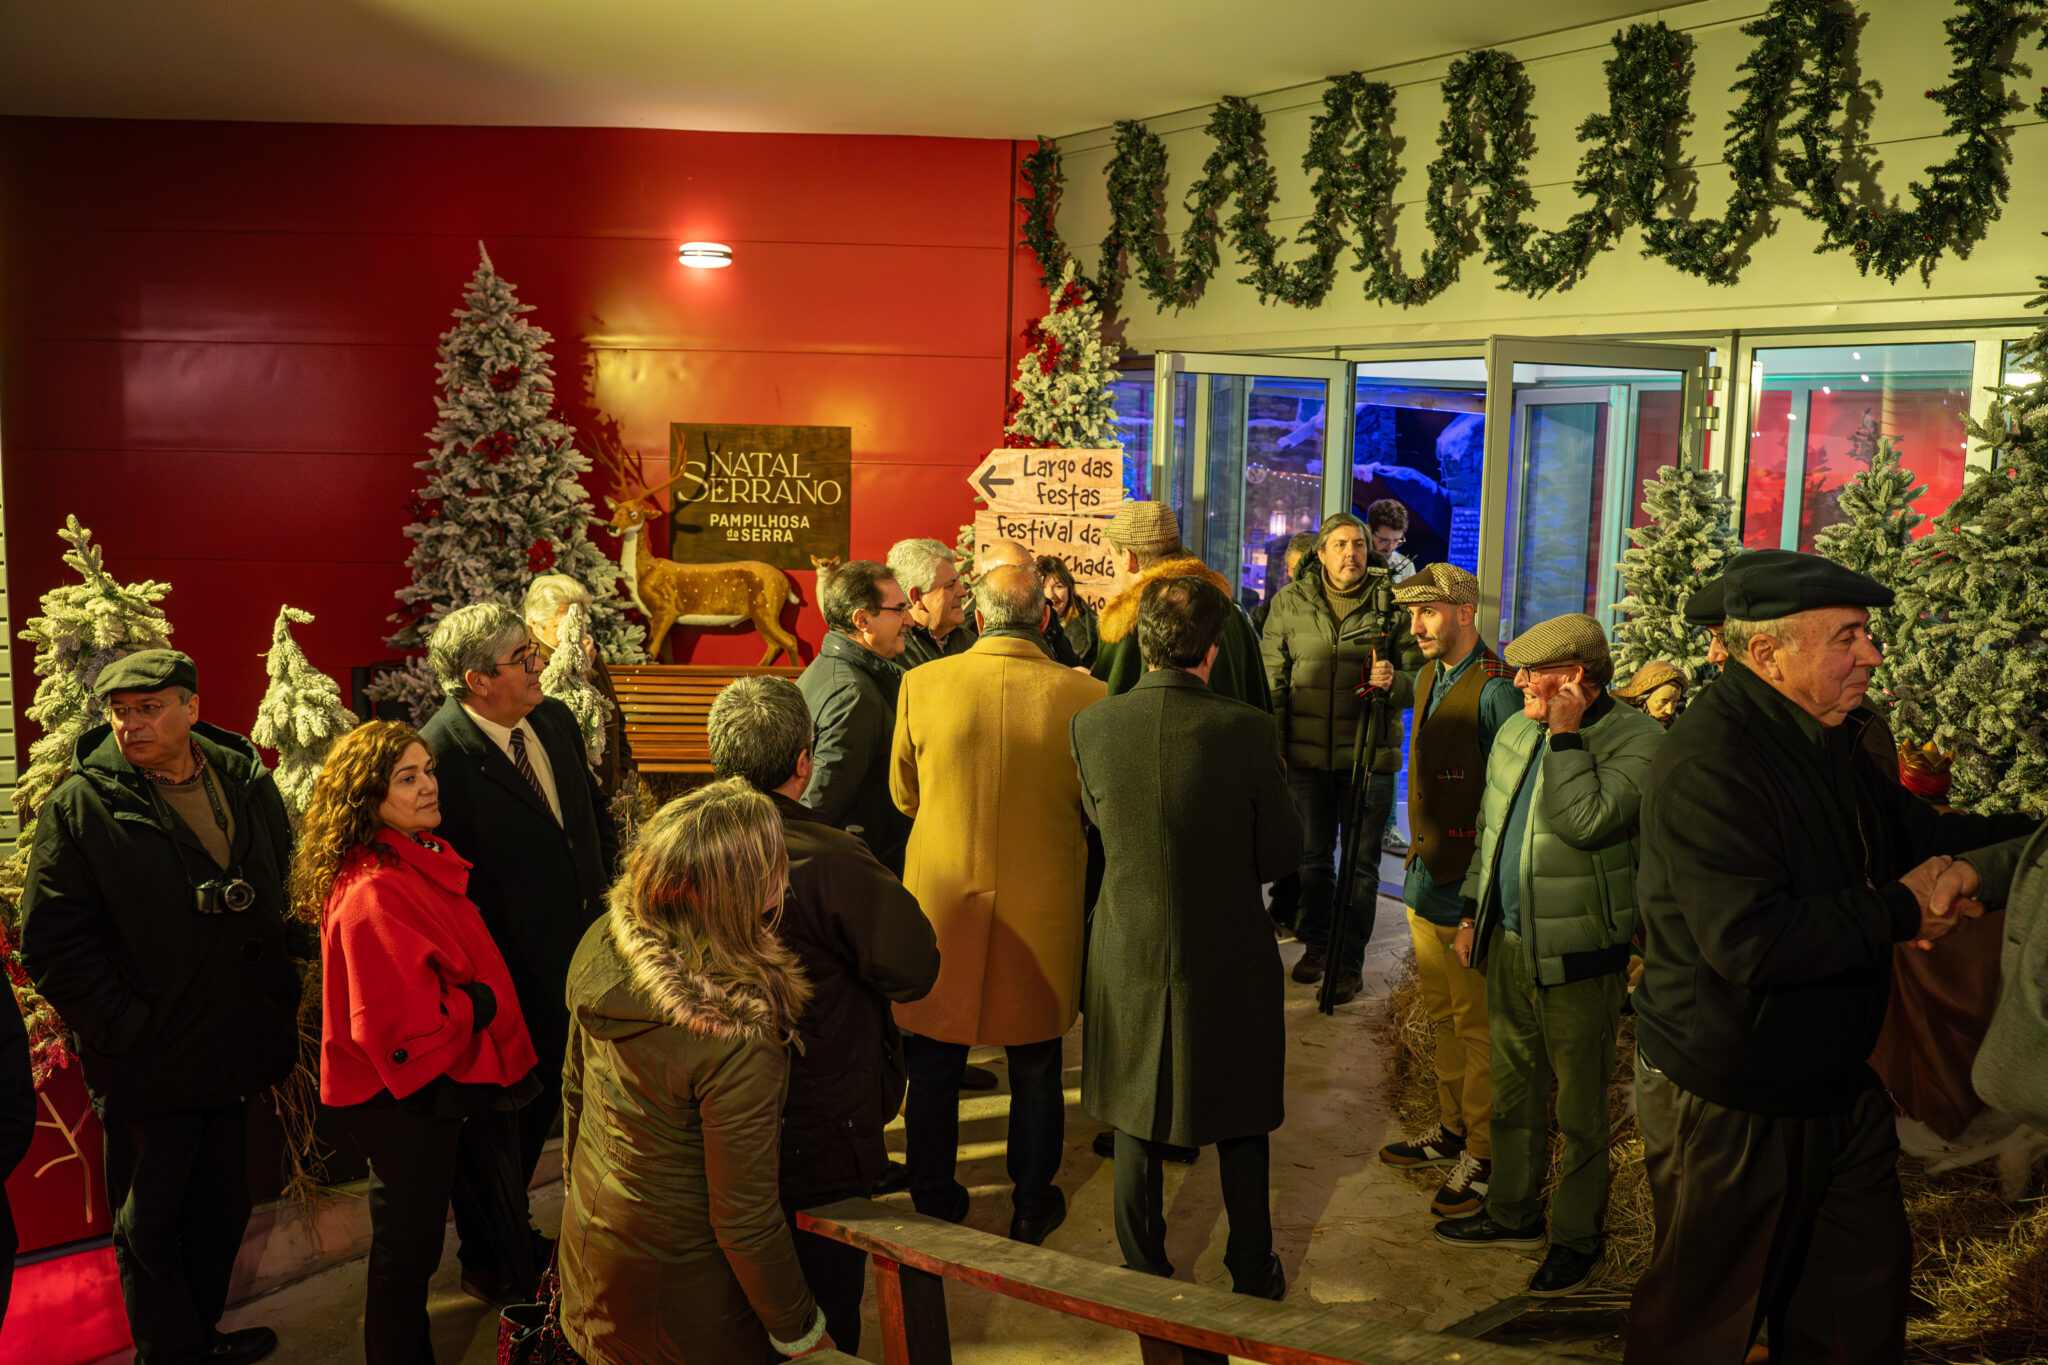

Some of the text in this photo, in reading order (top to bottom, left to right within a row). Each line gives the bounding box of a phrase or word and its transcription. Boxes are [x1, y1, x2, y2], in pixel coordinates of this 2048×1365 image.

[710, 451, 811, 478] NATAL
[1023, 454, 1113, 483] Largo das
[677, 460, 842, 505] SERRANO
[709, 513, 810, 529] PAMPILHOSA
[726, 528, 794, 543] da SERRA
[1079, 523, 1101, 546] da
